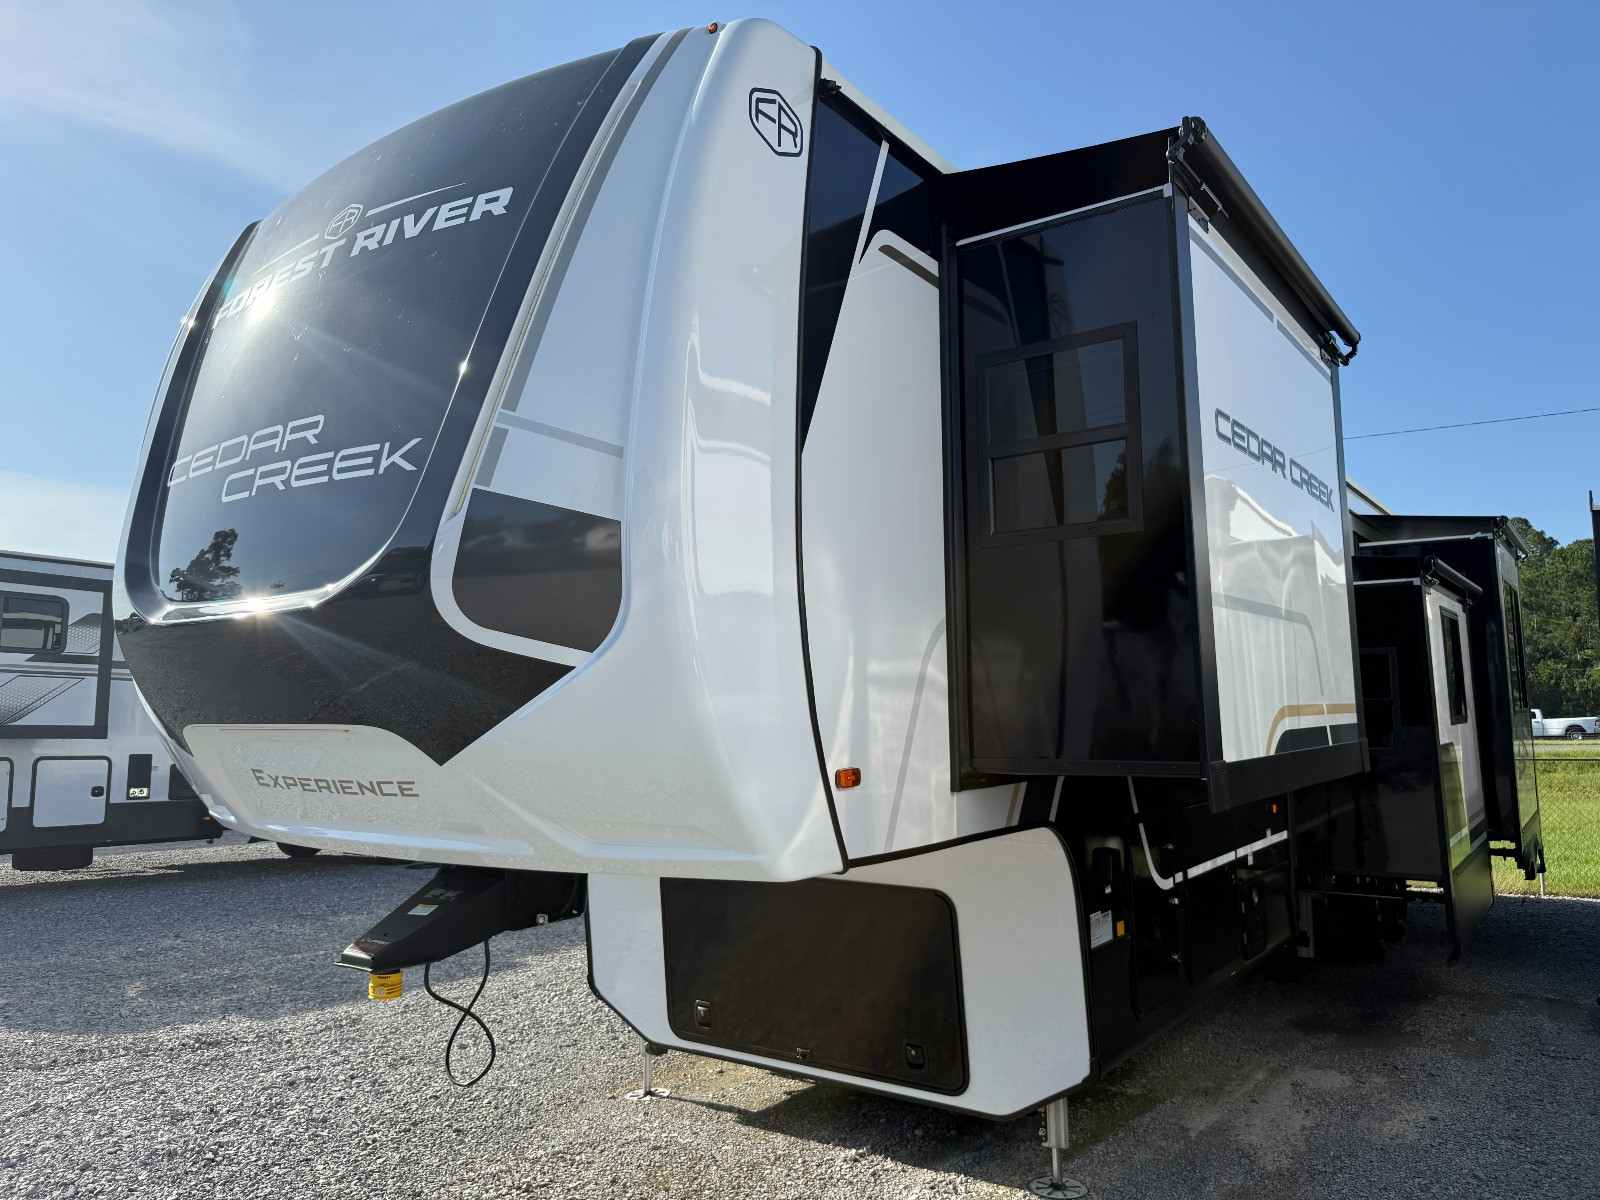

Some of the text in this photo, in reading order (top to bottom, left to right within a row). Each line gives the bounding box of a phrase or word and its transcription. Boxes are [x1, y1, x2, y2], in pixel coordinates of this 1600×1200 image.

[212, 187, 513, 329] FOREST RIVER
[167, 414, 325, 487] CEDAR
[221, 437, 423, 503] CREEK
[1215, 408, 1335, 512] CEDAR CREEK
